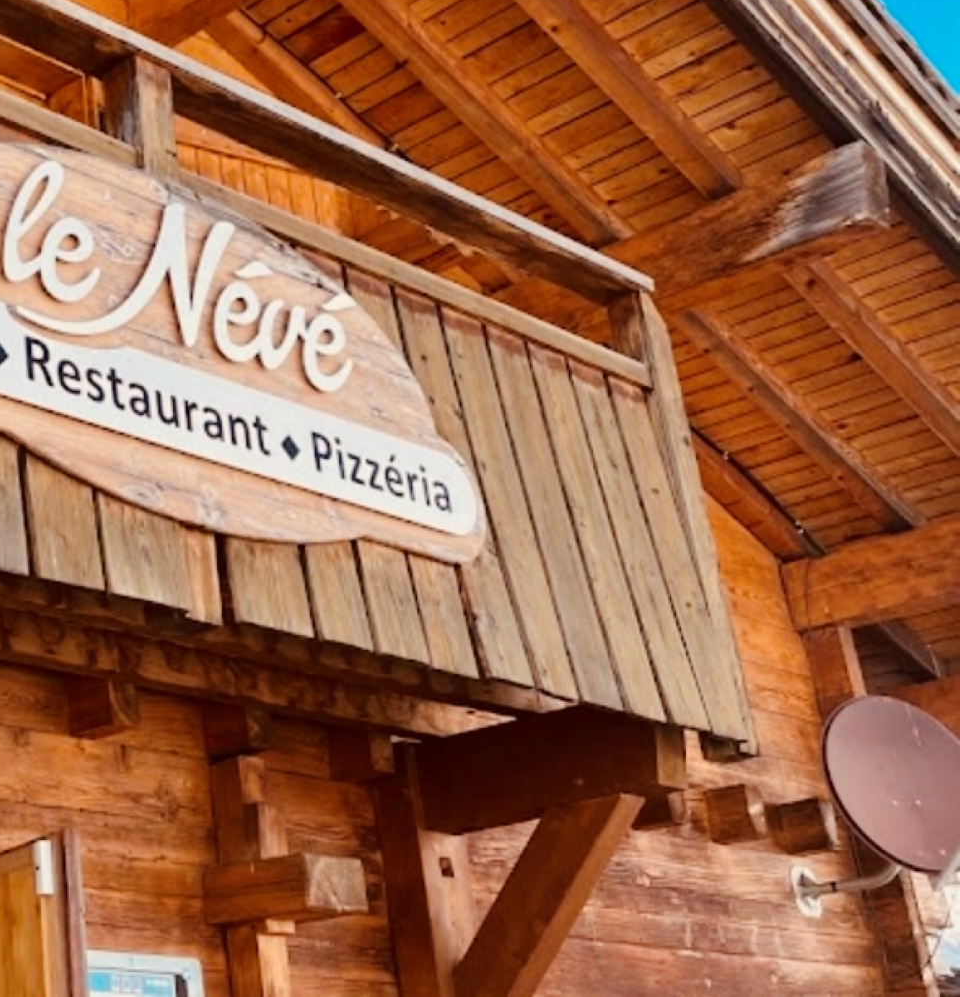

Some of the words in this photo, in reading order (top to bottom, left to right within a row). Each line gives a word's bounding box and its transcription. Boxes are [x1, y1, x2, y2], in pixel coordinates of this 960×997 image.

[2, 160, 101, 302] le
[16, 203, 357, 393] Névé
[25, 337, 272, 457] Restaurant
[311, 431, 452, 513] Pizzéria
